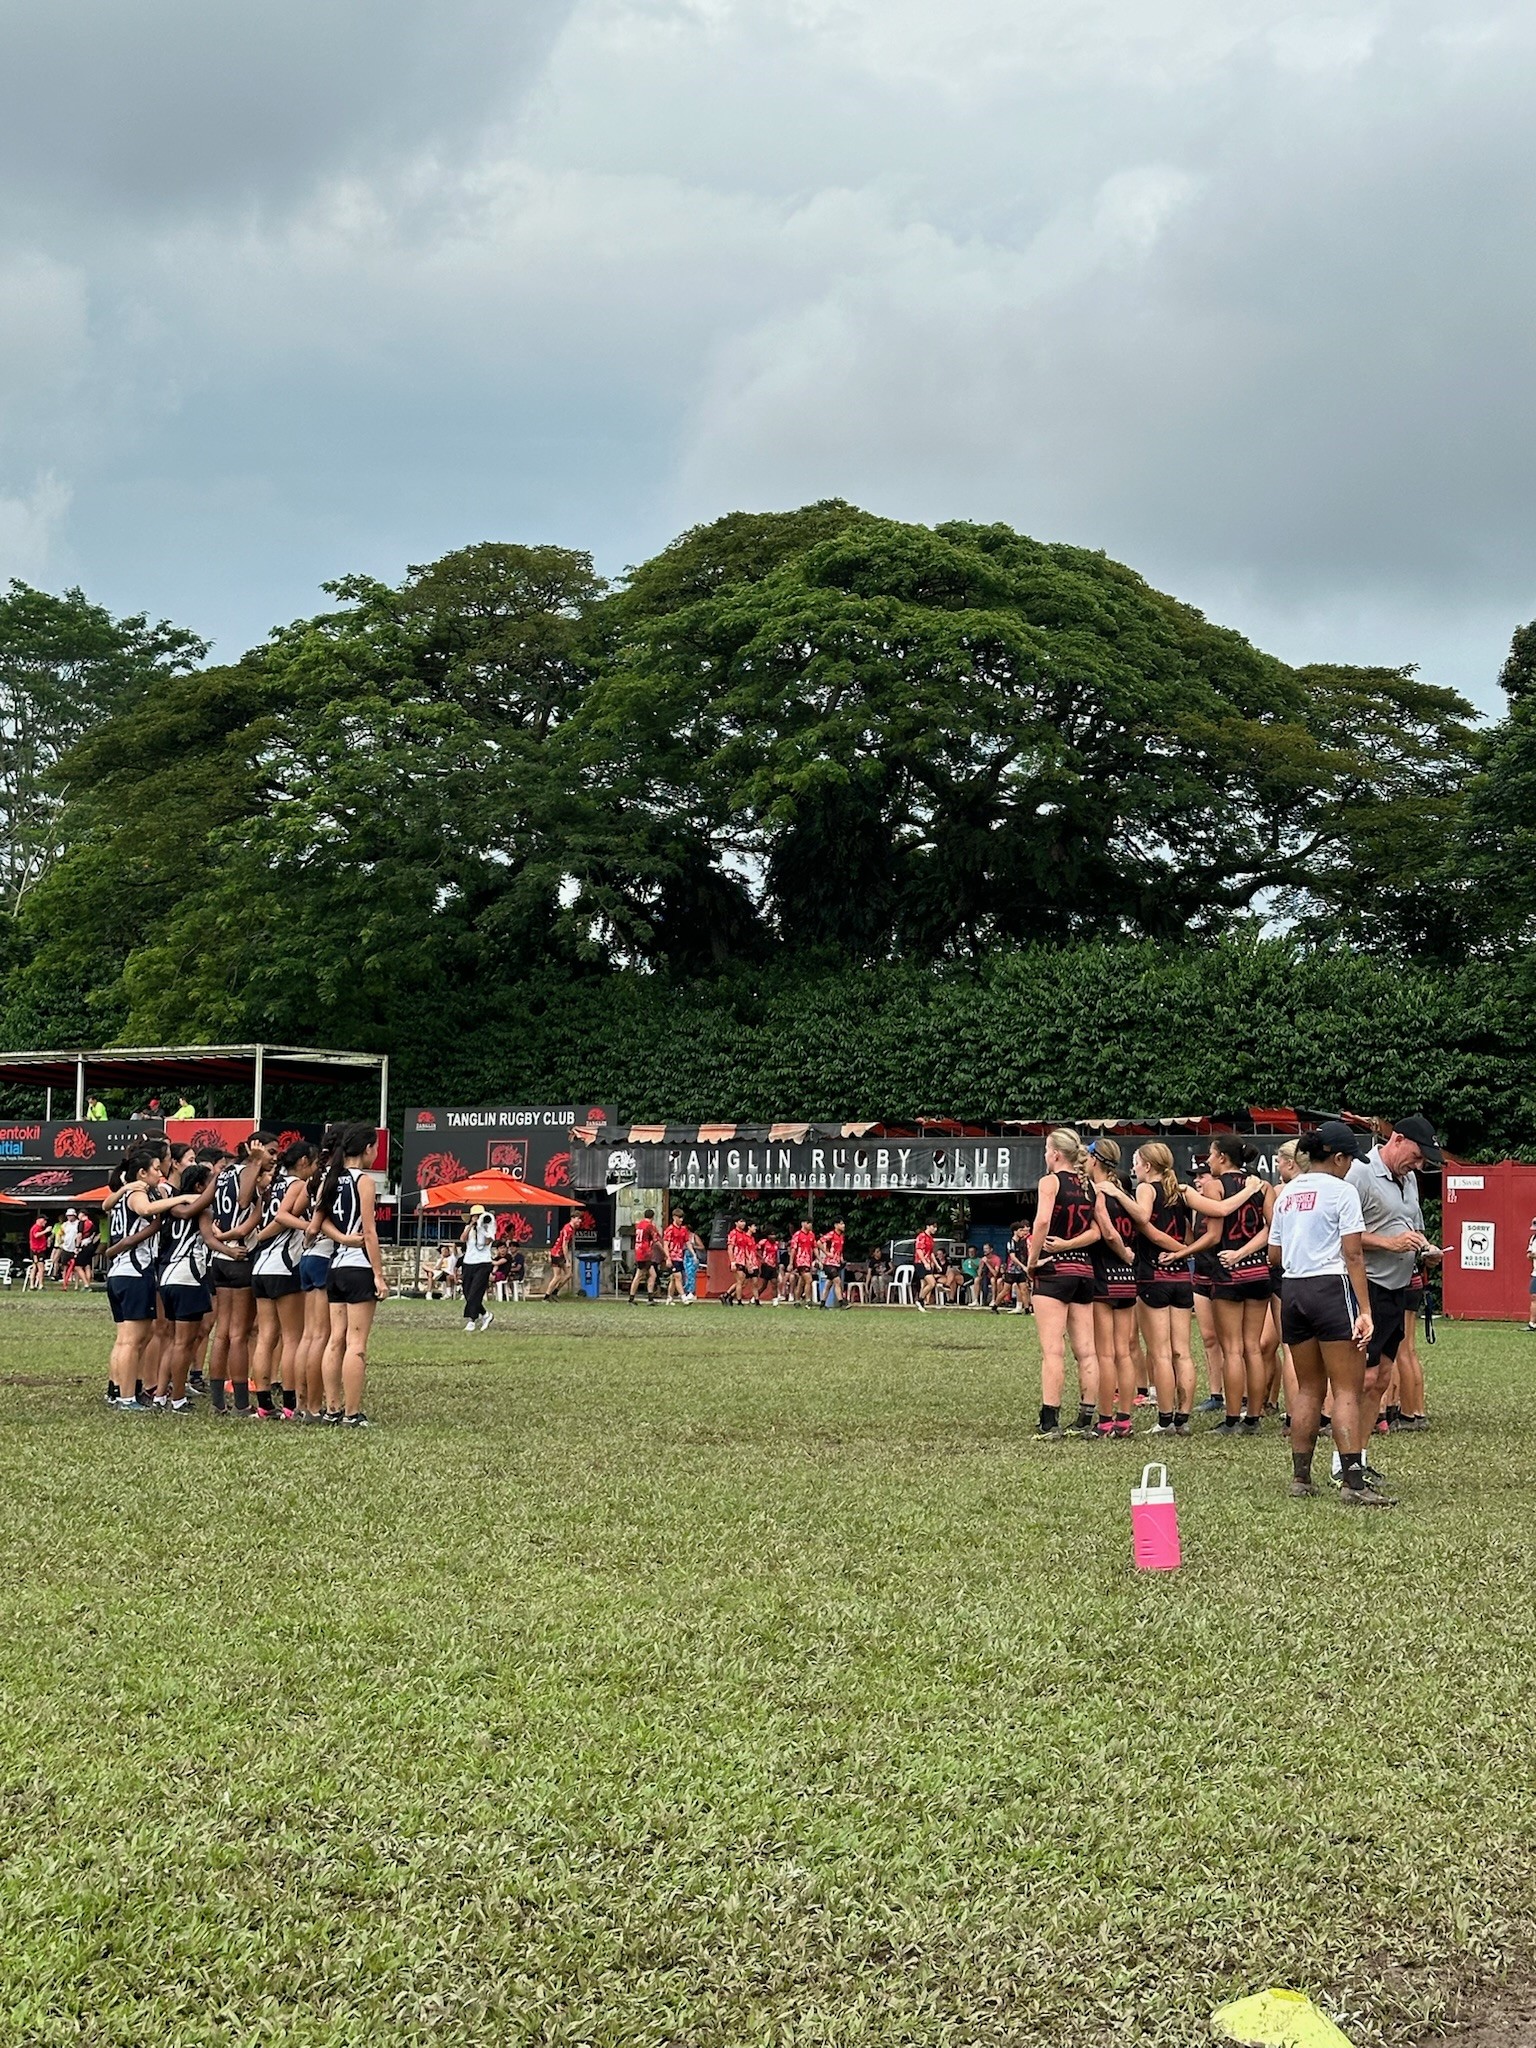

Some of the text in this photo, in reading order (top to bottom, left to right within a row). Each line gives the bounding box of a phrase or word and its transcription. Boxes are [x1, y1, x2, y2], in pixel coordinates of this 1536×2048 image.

[447, 1111, 575, 1127] TANGLIN RUGBY CLUB
[0, 1125, 41, 1140] entokil
[107, 1133, 139, 1141] CLIFF
[0, 1140, 24, 1155] itial
[737, 1173, 781, 1184] TOUCH
[789, 1173, 836, 1184] RUGBY
[844, 1173, 871, 1185] FOR
[965, 1172, 1010, 1185] IRLS
[214, 1186, 232, 1215] 16
[332, 1192, 345, 1221] 4
[110, 1208, 124, 1236] 20
[1066, 1203, 1091, 1239] 15
[1228, 1203, 1259, 1240] 20
